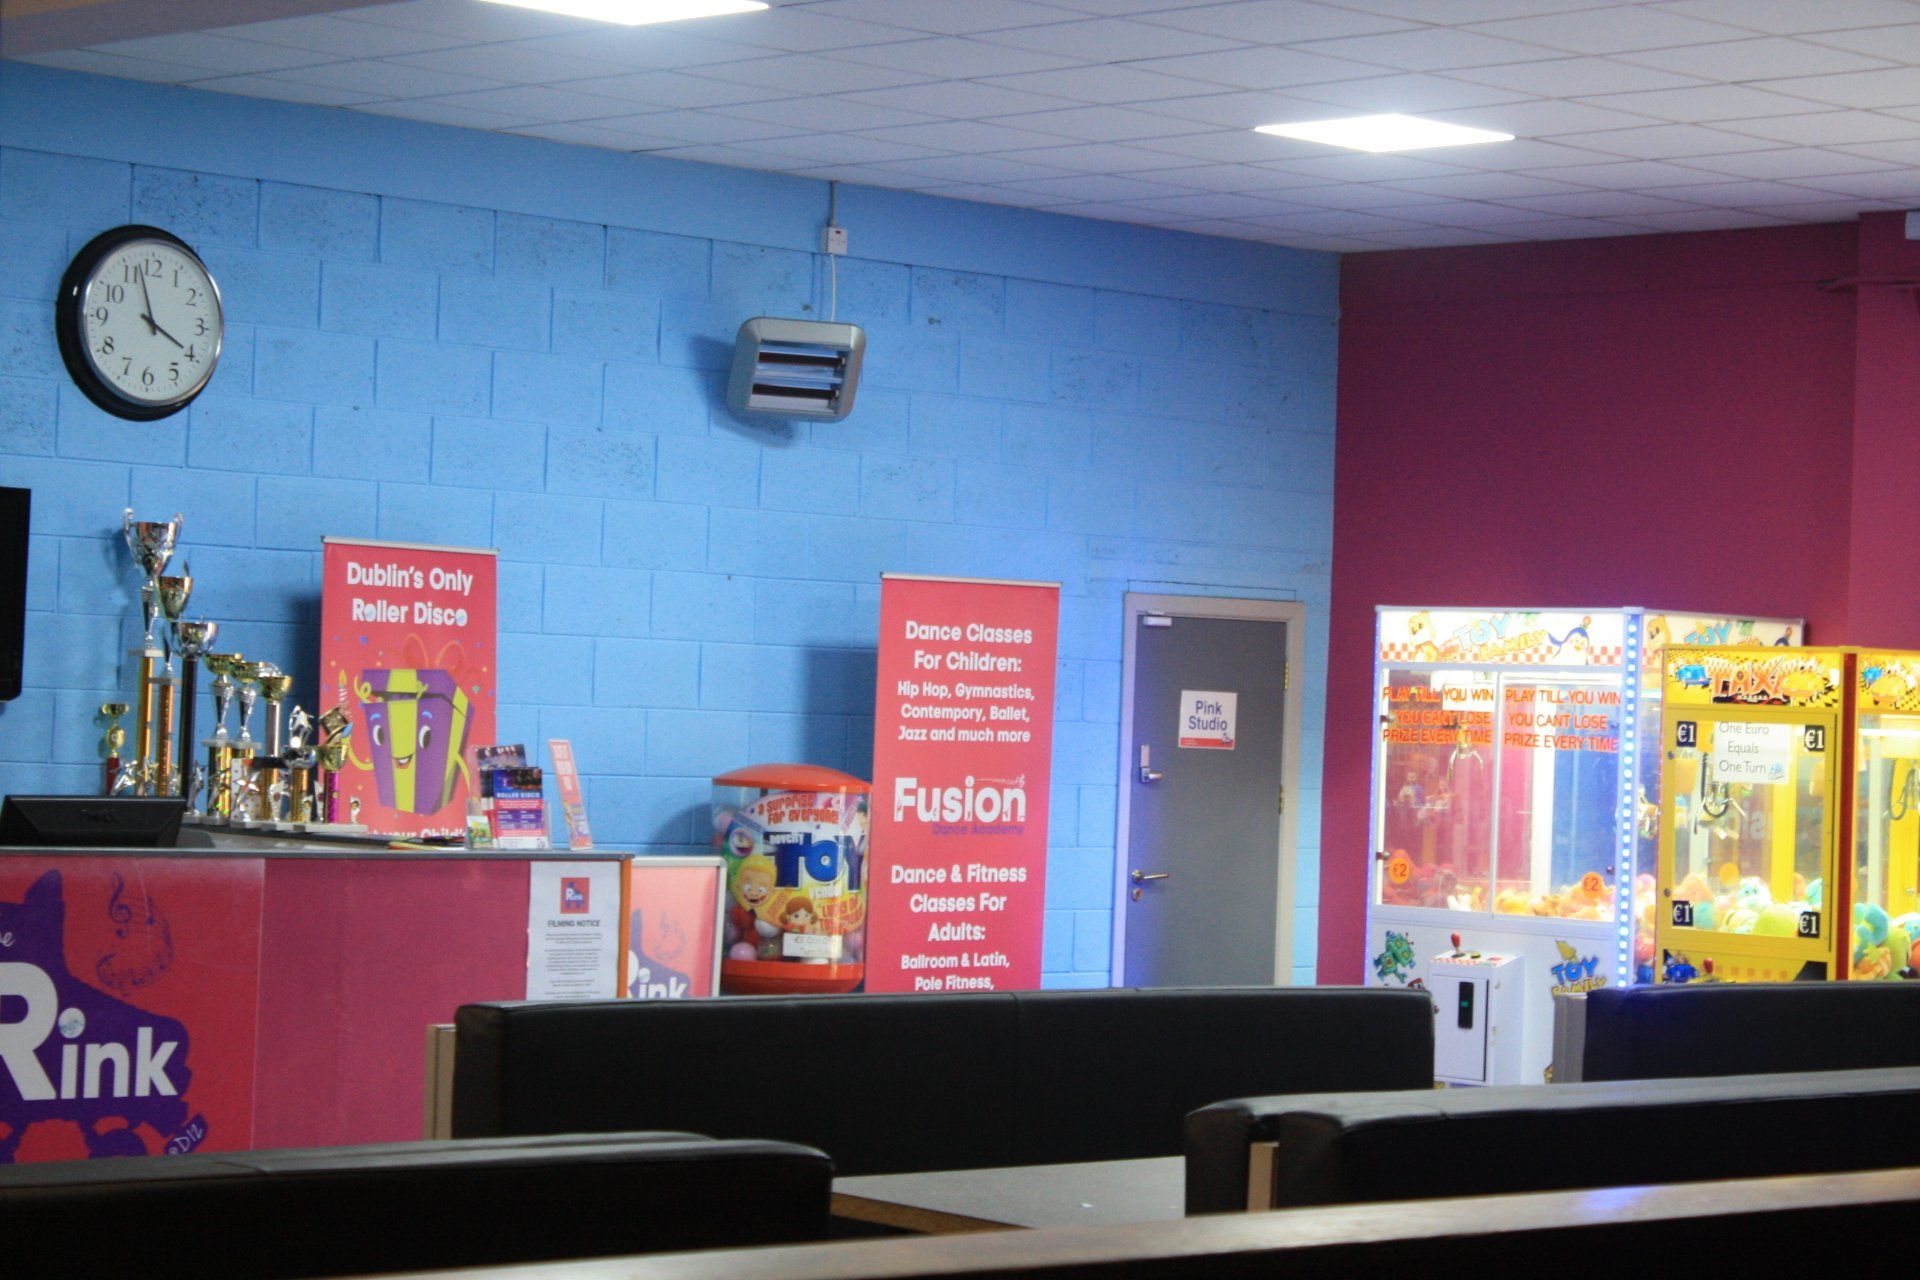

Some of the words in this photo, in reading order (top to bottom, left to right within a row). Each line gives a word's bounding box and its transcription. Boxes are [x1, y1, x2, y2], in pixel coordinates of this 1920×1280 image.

[124, 265, 139, 284] 11
[144, 258, 163, 278] 12
[106, 284, 125, 304] 10
[186, 288, 197, 306] 2
[96, 306, 109, 326] 9
[194, 318, 205, 337] 3
[102, 336, 115, 355] 8
[184, 344, 196, 362] 4
[122, 357, 133, 376] 7
[142, 366, 155, 386] 6
[169, 362, 180, 381] 5
[347, 561, 424, 589] Dublin's
[429, 567, 473, 596] Only
[352, 598, 409, 624] Roller
[414, 601, 468, 627] Disco
[906, 620, 961, 641] Dance
[966, 623, 1033, 644] Classes
[1452, 612, 1511, 652] TOY
[914, 650, 942, 670] For
[946, 651, 1022, 672] Children:
[897, 681, 919, 698] Hip
[922, 681, 951, 699] Hop,
[955, 682, 1035, 701] Gymnastics,
[1382, 686, 1411, 700] PLAY
[1415, 687, 1440, 702] TILL
[1442, 688, 1467, 701] YOU
[1471, 688, 1494, 701] WIN
[1505, 689, 1535, 702] PLAY
[1539, 690, 1564, 703] TILL
[1568, 690, 1594, 704] YOU
[1598, 691, 1622, 705] WIN
[901, 704, 986, 722] Contempory,
[990, 706, 1030, 723] Ballet,
[1196, 700, 1222, 715] Pink
[1188, 716, 1228, 731] Studio
[1396, 710, 1420, 724] YOU
[1458, 711, 1491, 725] LOSE
[1508, 713, 1533, 726] YOU
[1574, 715, 1608, 729] LOSE
[898, 726, 927, 741] Jazz
[930, 727, 955, 741] and
[958, 728, 994, 742] much
[997, 730, 1031, 742] more
[1382, 729, 1418, 743] PRIZE
[1420, 729, 1459, 744] EVERY
[1462, 730, 1492, 744] TIME
[1677, 723, 1696, 743] €1
[1719, 722, 1743, 734] One
[1745, 724, 1770, 735] Euro
[1504, 733, 1540, 747] PRIZE
[1544, 735, 1586, 749] EVERY
[1588, 736, 1619, 751] TIME
[1728, 741, 1760, 755] Equals
[1804, 730, 1824, 749] €1
[1719, 760, 1742, 772] One
[1745, 761, 1767, 774] Turn
[894, 775, 1026, 822] Fusion
[891, 864, 947, 883] Dance
[951, 864, 962, 883] &
[967, 863, 1027, 883] Fitness
[910, 894, 975, 912] Classes
[980, 893, 1007, 911] For
[1673, 904, 1691, 923] €1
[928, 923, 986, 941] Adults:
[1799, 916, 1818, 934] €1
[901, 954, 958, 969] Ballroom
[961, 954, 970, 967] &
[974, 952, 1010, 968] Latin,
[1551, 956, 1599, 986] TOY
[915, 976, 942, 991] Pole
[946, 974, 994, 990] Fitness,
[0, 962, 178, 1101] Rink
